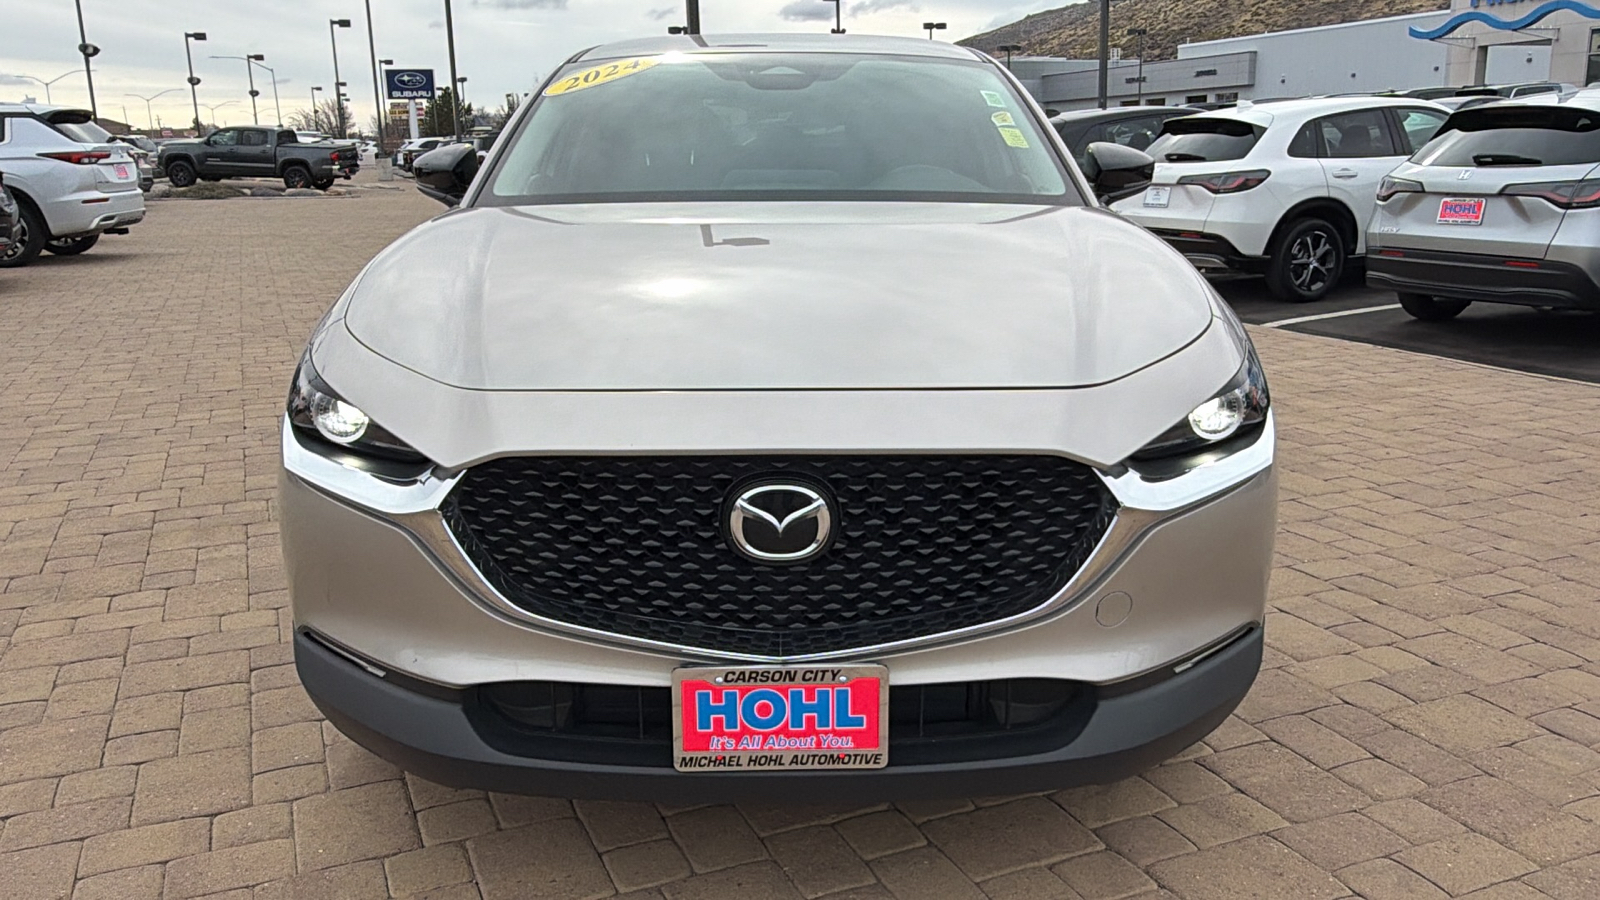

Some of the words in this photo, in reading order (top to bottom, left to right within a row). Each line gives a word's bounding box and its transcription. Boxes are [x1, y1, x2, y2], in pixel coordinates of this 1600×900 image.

[563, 60, 641, 92] 2024
[391, 90, 432, 98] SUBARU
[1444, 203, 1478, 214] HOHL
[723, 669, 798, 683] CARSON
[801, 668, 842, 682] CITY
[695, 687, 866, 732] HOHL
[709, 735, 735, 749] It's
[739, 735, 763, 749] All
[764, 734, 816, 749] About
[819, 734, 854, 748] You.
[679, 755, 743, 768] MICHAEL
[747, 754, 786, 767] HOHL
[788, 753, 883, 766] AUTOMOTIVE
